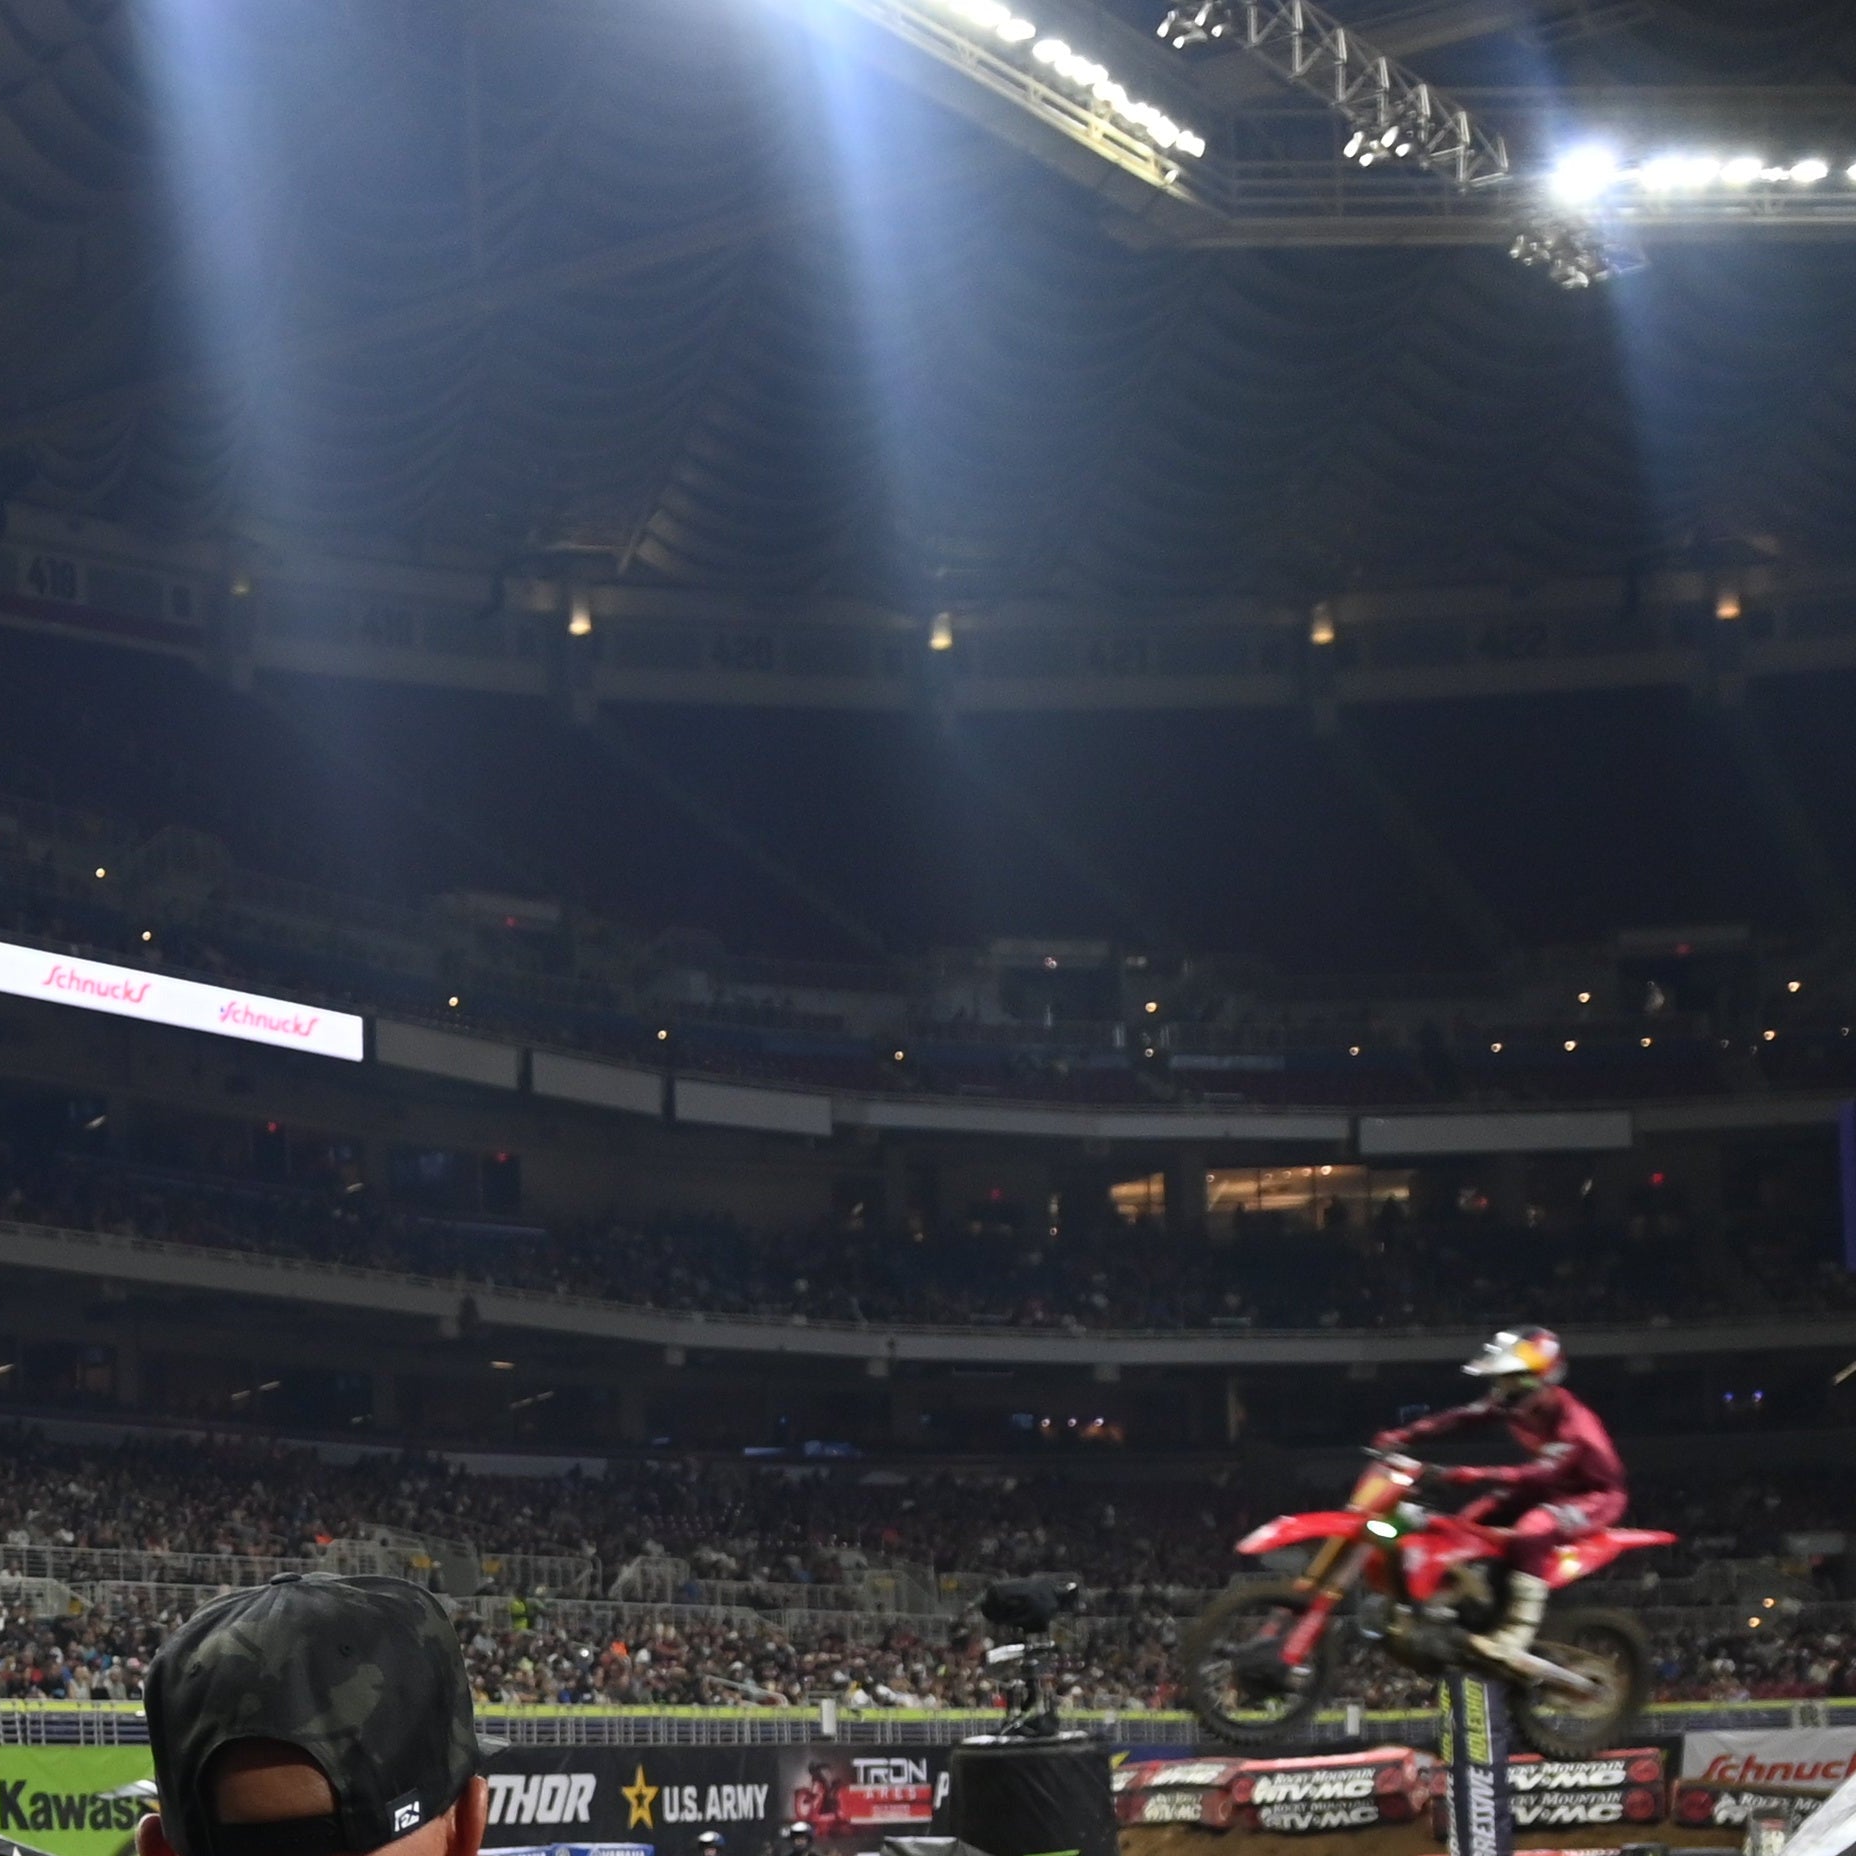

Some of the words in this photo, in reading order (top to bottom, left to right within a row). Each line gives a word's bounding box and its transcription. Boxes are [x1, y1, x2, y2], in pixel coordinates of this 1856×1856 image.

[852, 1757, 928, 1785] TRON
[486, 1773, 597, 1825] THOR
[662, 1785, 703, 1823] U.S.
[706, 1783, 769, 1821] ARMY
